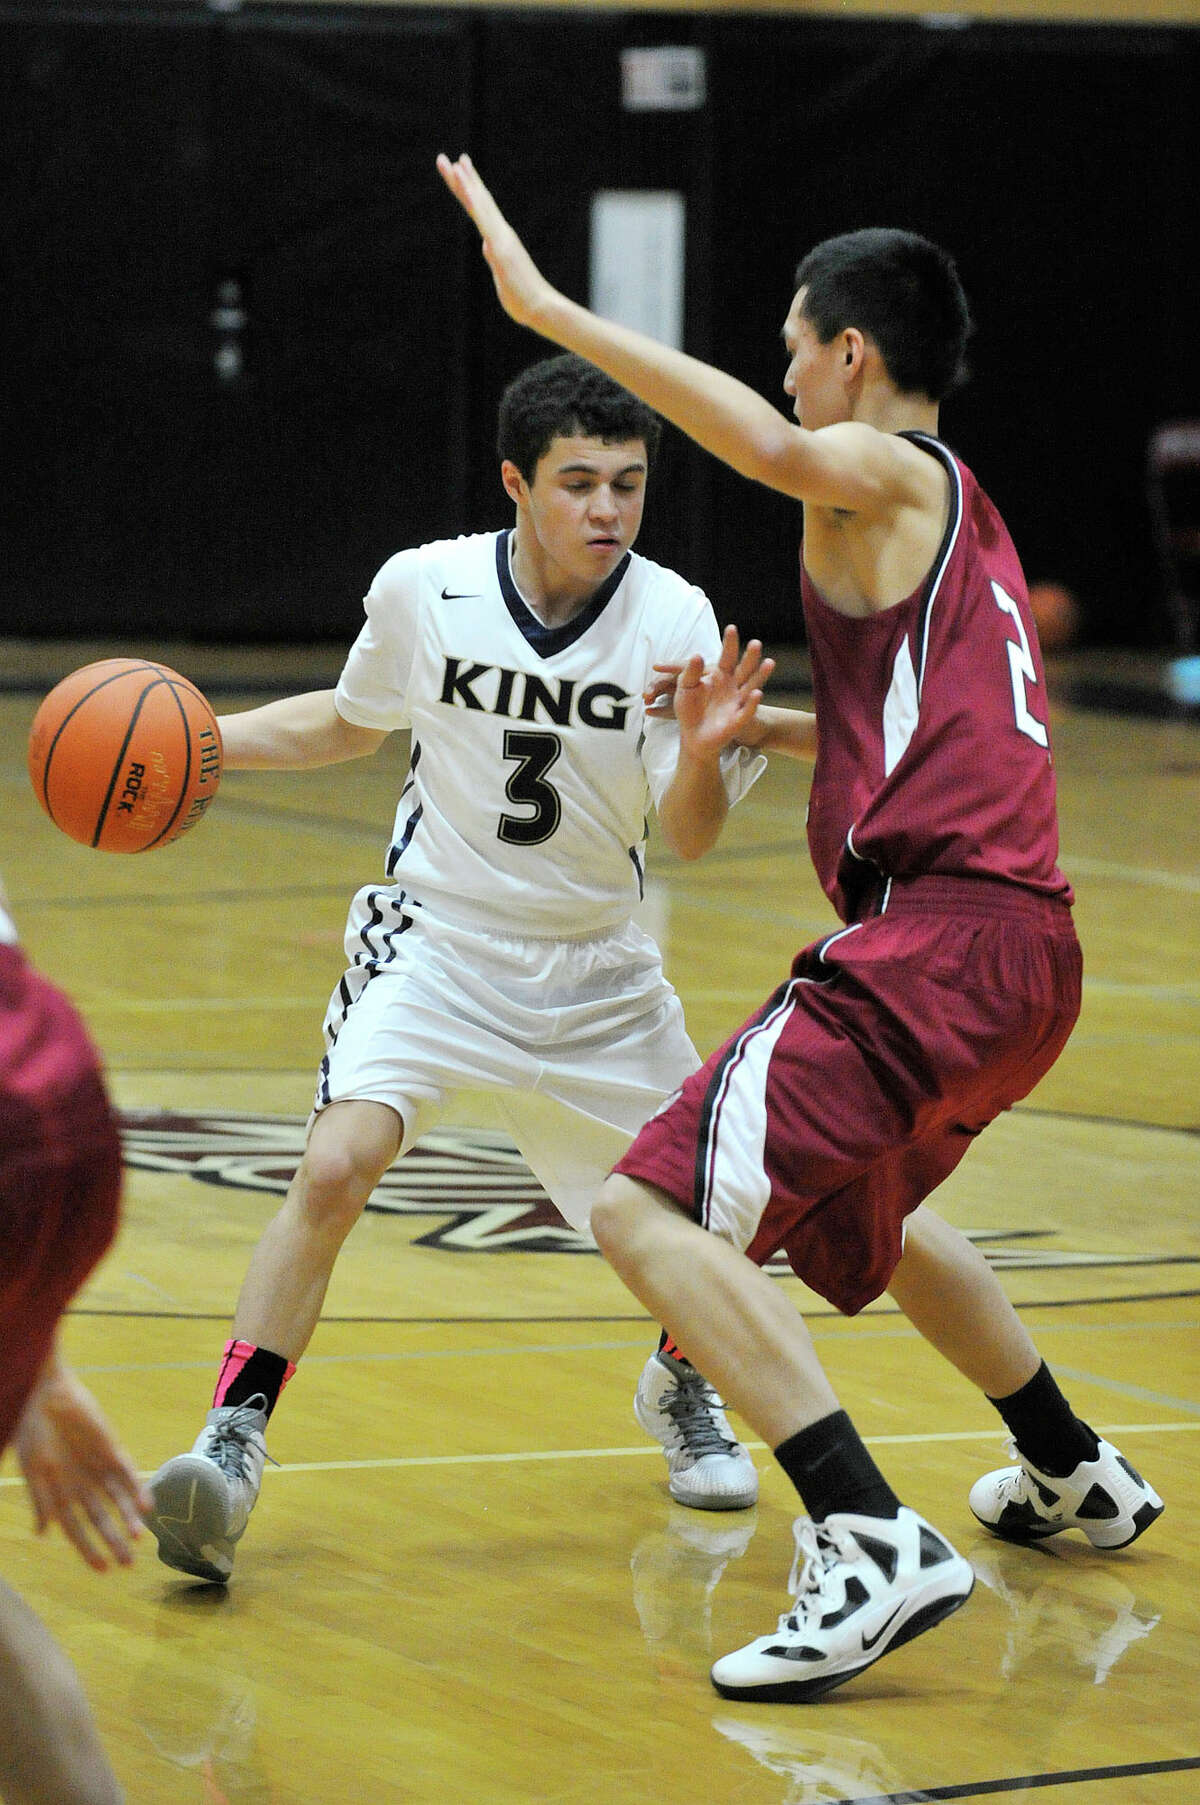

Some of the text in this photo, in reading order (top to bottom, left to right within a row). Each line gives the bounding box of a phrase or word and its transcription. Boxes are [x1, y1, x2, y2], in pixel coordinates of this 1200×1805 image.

[440, 656, 629, 729] KING
[990, 577, 1049, 748] 2
[118, 762, 145, 814] ROCK
[498, 730, 562, 846] 3
